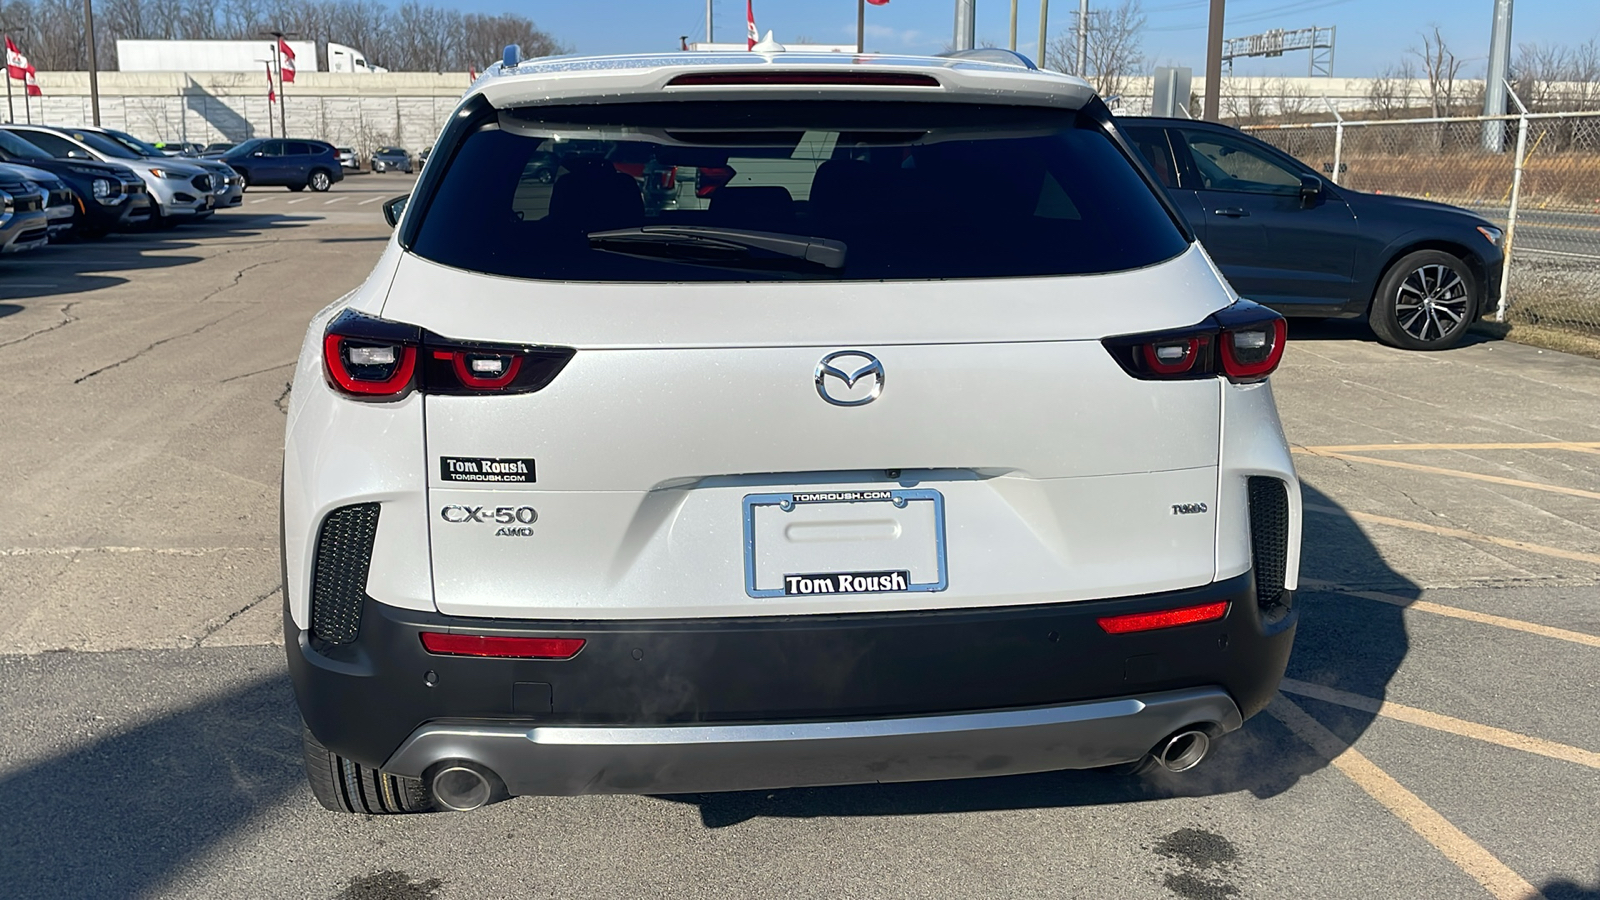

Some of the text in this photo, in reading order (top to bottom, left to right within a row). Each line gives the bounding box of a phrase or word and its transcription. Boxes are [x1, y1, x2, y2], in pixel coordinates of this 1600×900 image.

[447, 459, 528, 473] Tom Roush
[450, 473, 526, 482] TOMROUSH.COM
[793, 491, 891, 501] TOMROUSH.COM
[440, 504, 539, 525] CX-50
[495, 527, 534, 537] AWD
[786, 572, 907, 594] Tom Roush
